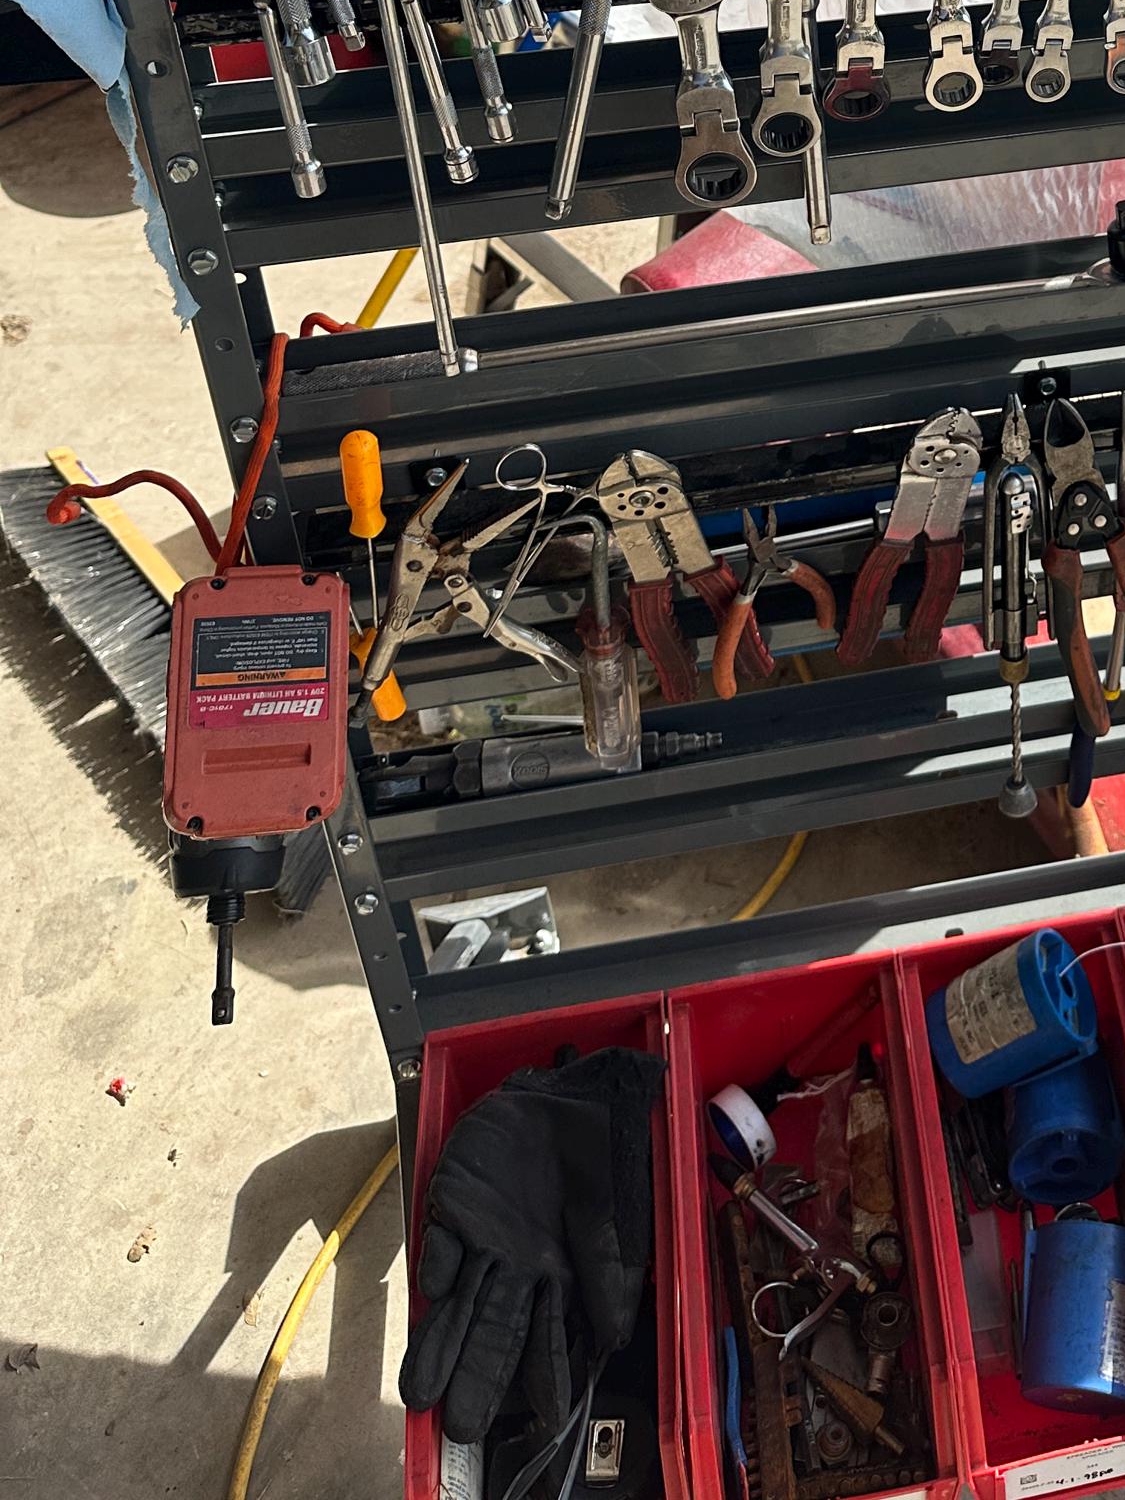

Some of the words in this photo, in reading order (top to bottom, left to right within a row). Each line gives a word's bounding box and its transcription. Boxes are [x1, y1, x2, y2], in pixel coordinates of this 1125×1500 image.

[238, 672, 280, 682] WARNING
[197, 695, 217, 704] PACK
[218, 693, 251, 702] BATTERY
[252, 691, 283, 700] LITHIUM
[243, 699, 323, 717] Bauer
